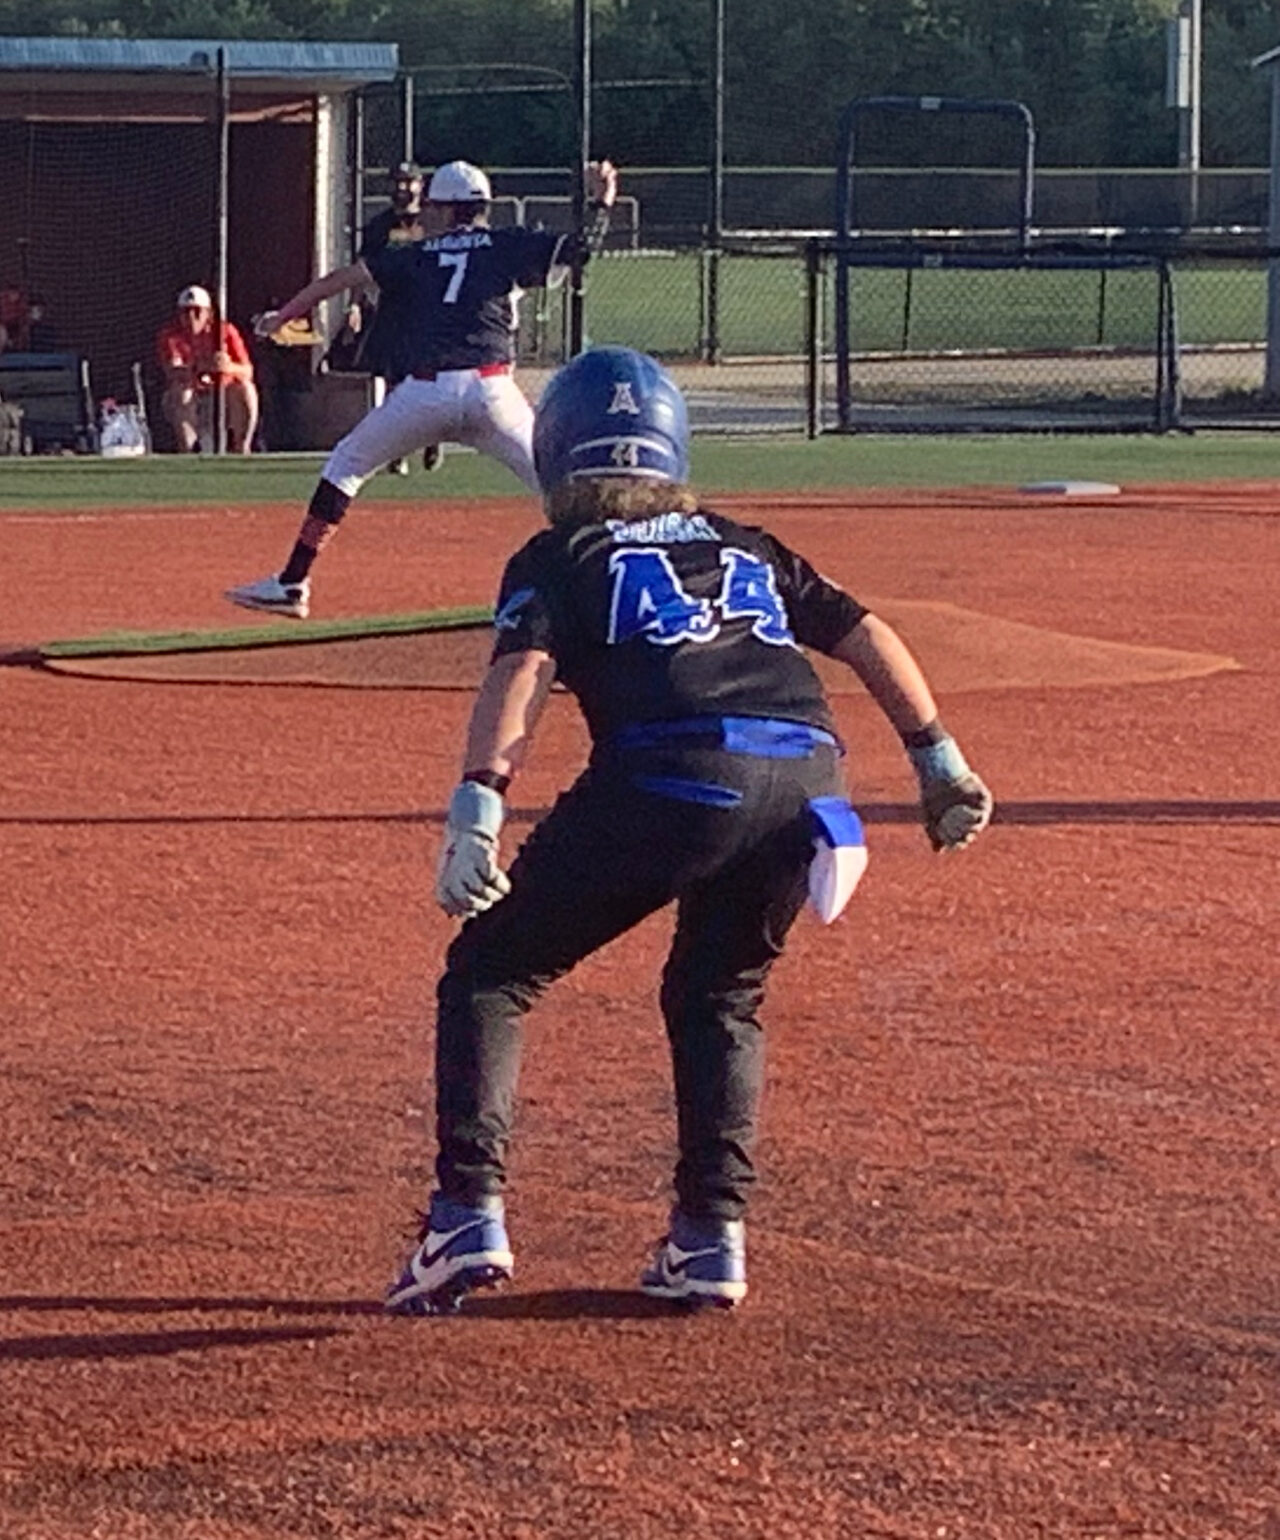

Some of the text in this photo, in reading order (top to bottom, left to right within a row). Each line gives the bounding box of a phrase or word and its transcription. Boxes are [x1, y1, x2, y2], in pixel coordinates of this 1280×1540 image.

[438, 252, 469, 303] 7
[607, 382, 640, 414] A
[606, 548, 805, 653] 44
